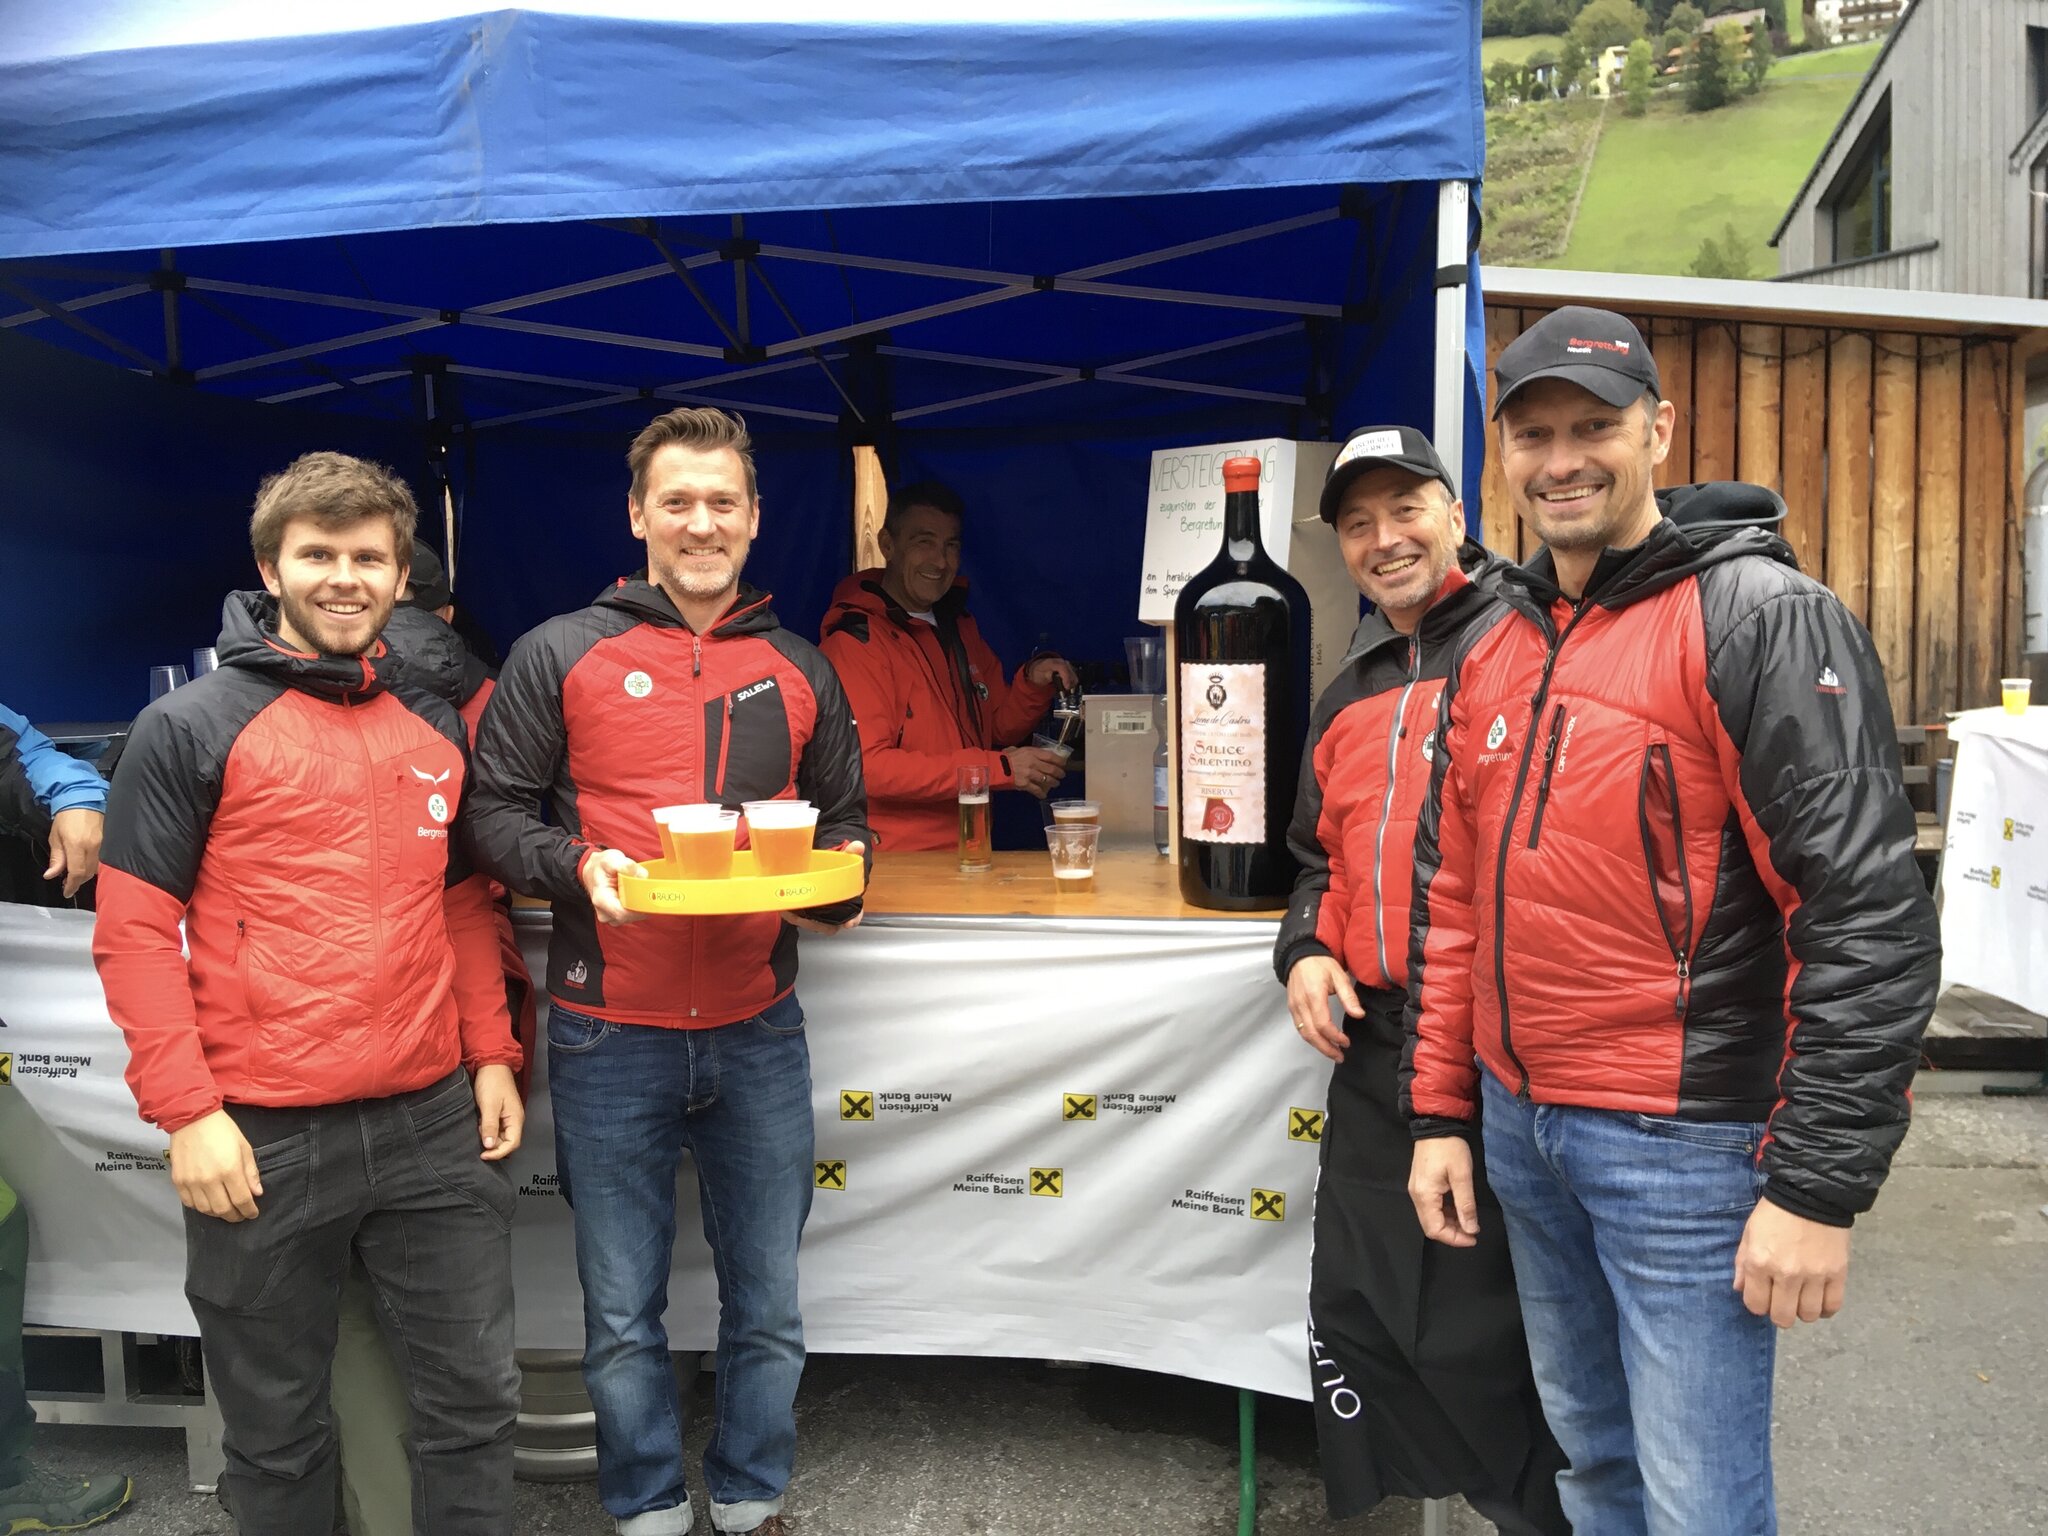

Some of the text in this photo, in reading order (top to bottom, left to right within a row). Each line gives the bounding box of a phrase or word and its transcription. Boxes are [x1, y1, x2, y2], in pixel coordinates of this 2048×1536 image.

[1204, 500, 1216, 511] der
[1557, 715, 1577, 773] ORTOVOX
[1201, 788, 1233, 796] RISERVA
[19, 1054, 91, 1066] Meine Bank
[17, 1066, 77, 1078] Raiffeisen
[879, 1092, 952, 1102] Meine Bank
[1103, 1093, 1177, 1104] Meine Bank
[879, 1103, 939, 1113] Raiffeisen
[1102, 1103, 1162, 1114] Raiffeisen
[95, 1161, 166, 1172] Meine Bank
[966, 1173, 1024, 1185] Raiffeisen
[519, 1186, 555, 1196] Meine
[953, 1183, 1024, 1194] Meine Bank
[1185, 1189, 1245, 1205] Raiffeisen
[1171, 1199, 1245, 1216] Meine Bank
